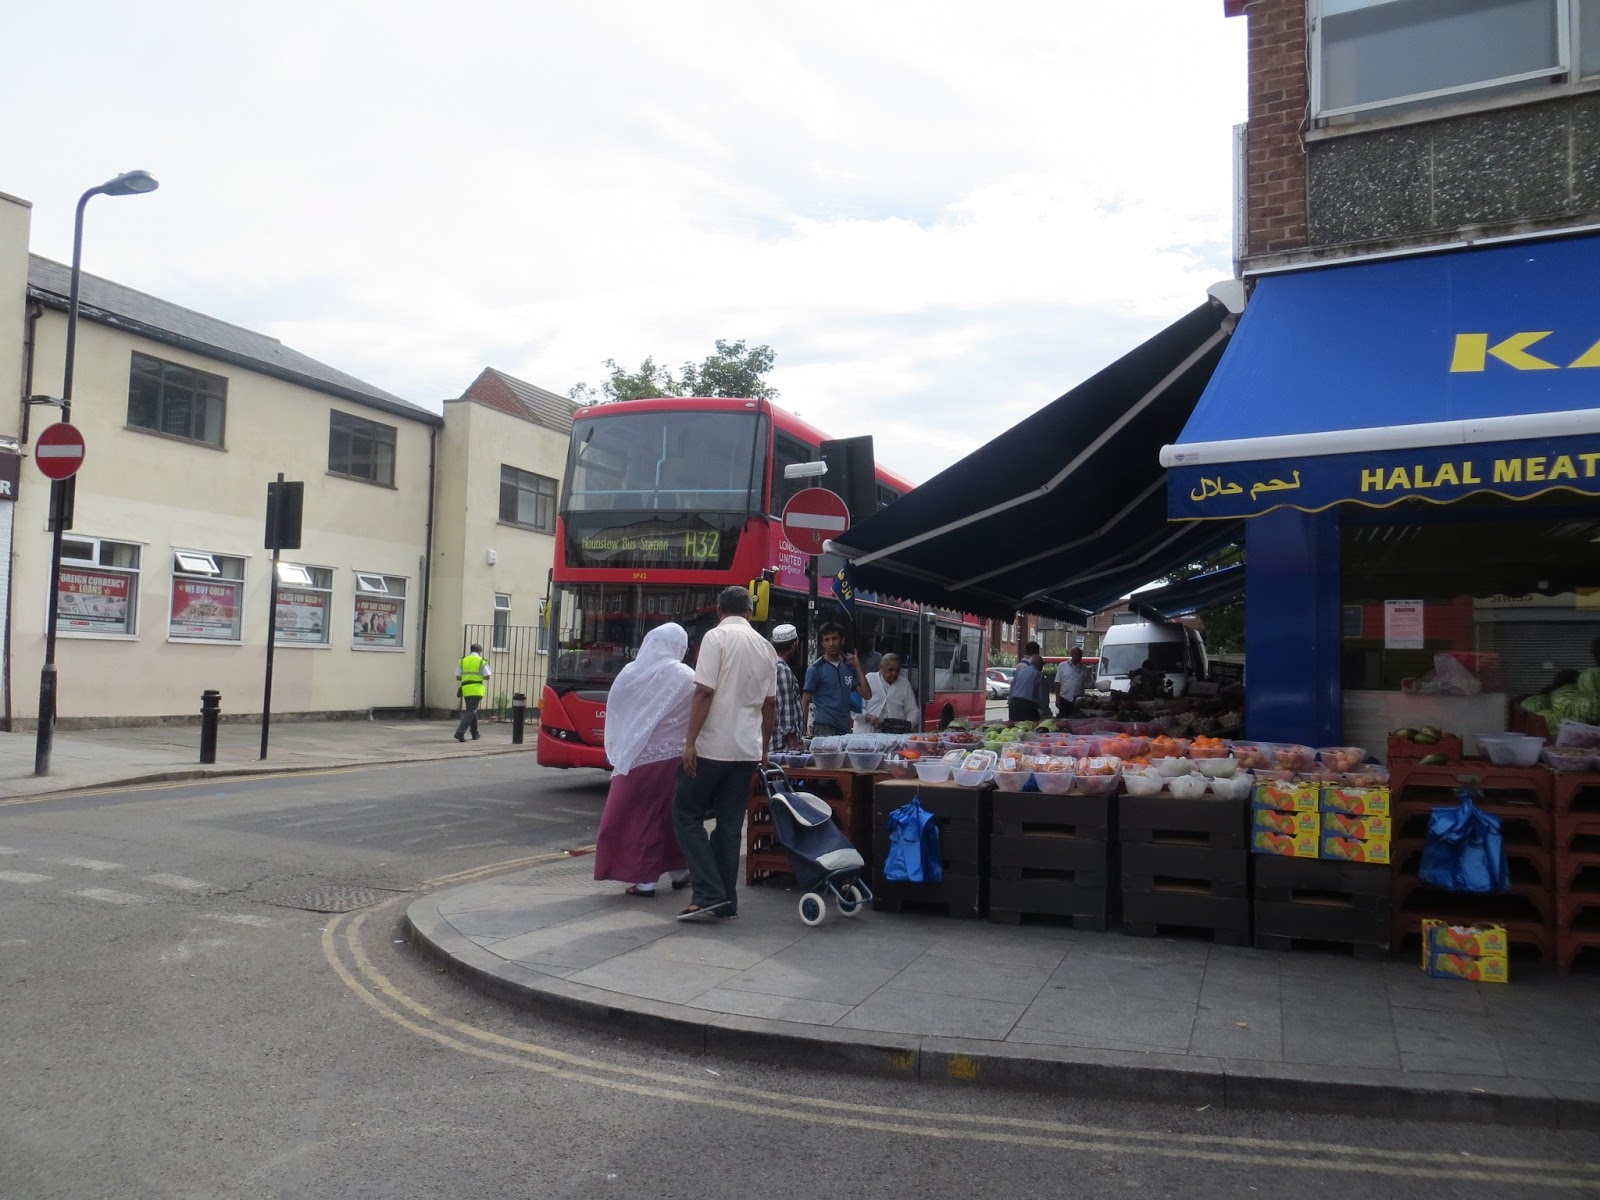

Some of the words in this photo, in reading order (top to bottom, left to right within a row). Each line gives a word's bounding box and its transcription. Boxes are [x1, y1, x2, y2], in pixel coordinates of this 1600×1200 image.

[1361, 461, 1480, 492] HALAL
[1190, 476, 1243, 501] حلال
[1250, 470, 1300, 501] لحم
[582, 537, 619, 550] Hounslow
[622, 537, 637, 549] Bus
[641, 538, 669, 551] Station
[685, 530, 719, 557] H32
[779, 552, 802, 566] UNITED
[88, 576, 125, 588] CURRENCY
[79, 584, 102, 595] LOANS
[185, 584, 195, 593] WE
[196, 585, 208, 594] BUY
[209, 586, 225, 596] GOLD
